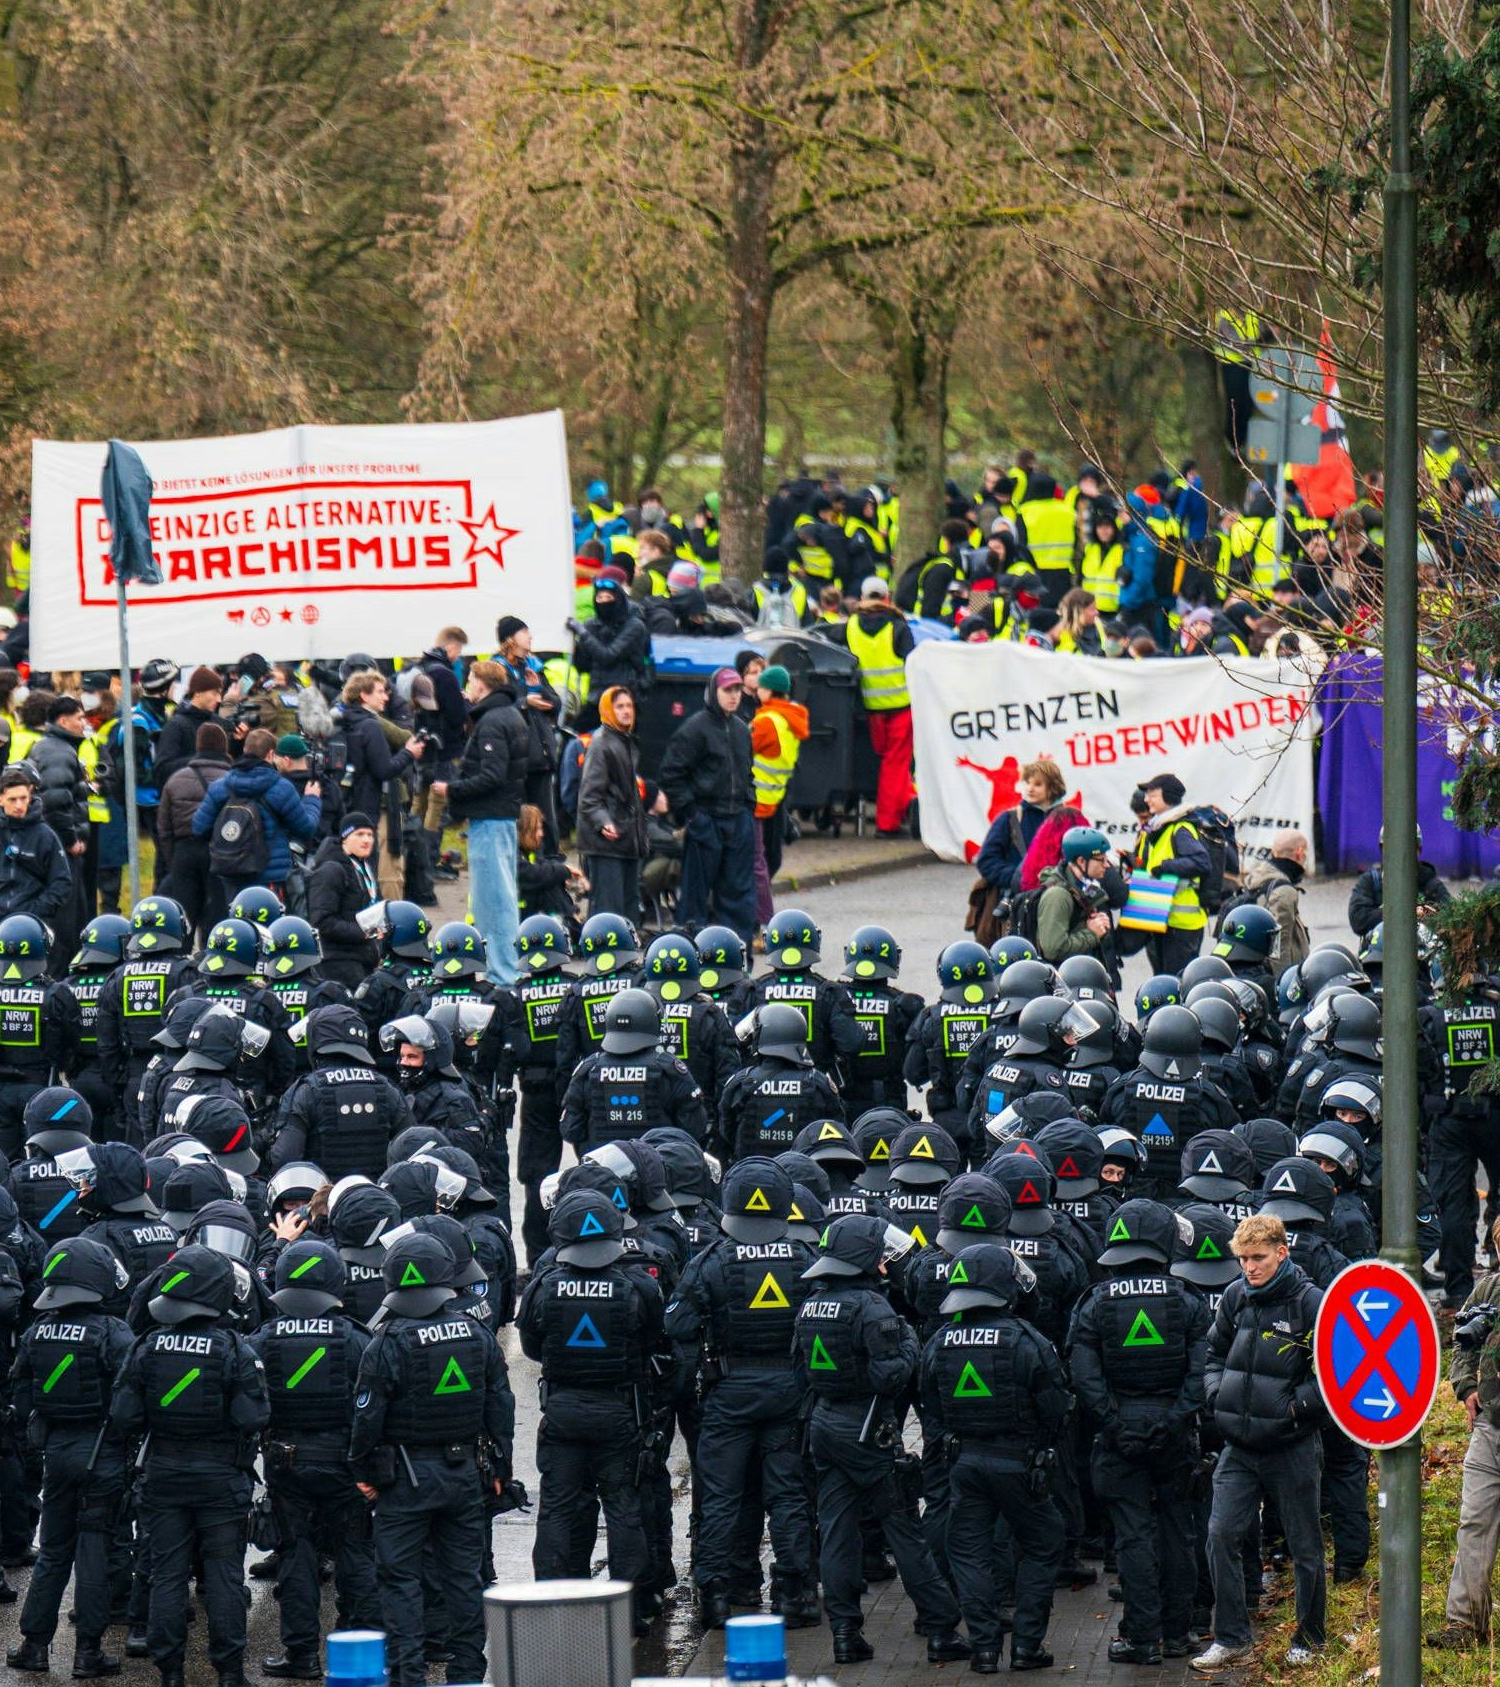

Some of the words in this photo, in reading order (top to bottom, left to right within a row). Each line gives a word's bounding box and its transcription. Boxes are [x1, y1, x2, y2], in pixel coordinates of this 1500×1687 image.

[199, 475, 232, 488] KEINE
[296, 463, 316, 476] FÜR
[319, 464, 360, 475] UNSERE
[363, 463, 421, 475] PROBLEME
[150, 509, 256, 542] EINZIGE
[266, 499, 452, 531] ALTERNATIVE:
[951, 688, 1120, 741] GRENZEN
[1065, 690, 1312, 767] ÜBERWINDEN
[134, 915, 143, 929] 3
[155, 913, 165, 927] 2
[235, 905, 243, 918] 3
[258, 908, 268, 923] 2
[418, 920, 427, 934] 3
[1235, 924, 1246, 939] 2
[88, 929, 98, 943] 2
[207, 935, 215, 950] 3
[226, 937, 238, 952] 2
[289, 934, 299, 948] 2
[520, 937, 529, 951] 3
[544, 933, 554, 947] 2
[585, 937, 593, 952] 3
[607, 932, 617, 947] 2
[771, 929, 780, 943] 3
[802, 929, 812, 943] 2
[19, 941, 29, 955] 2
[435, 940, 443, 955] 3
[464, 937, 474, 951] 2
[849, 941, 858, 956] 3
[879, 943, 890, 957] 2
[716, 949, 726, 963] 2
[999, 952, 1008, 965] 3
[124, 961, 172, 976] POLIZEI
[653, 958, 661, 973] 3
[677, 957, 687, 972] 2
[952, 966, 962, 980] 3
[976, 962, 986, 976] 2
[131, 980, 155, 991] NRW
[581, 979, 632, 996] POLIZEI
[765, 986, 817, 1000] POLIZEI
[128, 991, 134, 1001] 3
[135, 991, 147, 1001] BF
[147, 991, 158, 1001] 24
[1141, 995, 1151, 1010] 3
[5, 1010, 30, 1022] NRW
[535, 1004, 560, 1016] NRW
[2, 1022, 8, 1032] 3
[9, 1022, 21, 1032] BF
[22, 1022, 33, 1032] 23
[534, 1018, 540, 1027] 3
[541, 1016, 553, 1027] BF
[592, 1015, 598, 1025] 3
[952, 1020, 977, 1031] NRW
[672, 1035, 681, 1044] 22
[867, 1032, 878, 1042] 22
[949, 1032, 955, 1042] 3
[956, 1032, 968, 1042] BF
[1458, 1029, 1483, 1040] NRW
[1455, 1042, 1461, 1051] 3
[1463, 1041, 1475, 1050] BF
[1477, 1041, 1487, 1049] 21
[326, 1069, 375, 1083] POLIZEI
[600, 1067, 647, 1082] POLIZEI
[988, 1064, 1020, 1083] POLIZEI
[1136, 1083, 1186, 1100] POLIZEI
[610, 1111, 623, 1122] SH
[626, 1110, 643, 1122] 215
[759, 1130, 771, 1140] SH
[772, 1130, 785, 1140] 215
[787, 1131, 793, 1140] B
[1141, 1134, 1154, 1146] SH
[889, 1196, 938, 1211] POLIZE
[133, 1225, 175, 1244] POLIZEI
[736, 1243, 793, 1260] POLIZEI
[557, 1280, 613, 1298] POLIZEI
[1109, 1278, 1168, 1297] POLIZEI
[801, 1301, 841, 1319] POLIZEI
[35, 1323, 86, 1341] POLIZEI
[276, 1318, 333, 1335] POLIZEI
[418, 1321, 472, 1345] POLIZEI
[944, 1328, 1000, 1346] POLIZEI
[155, 1335, 212, 1355] POLIZEI
